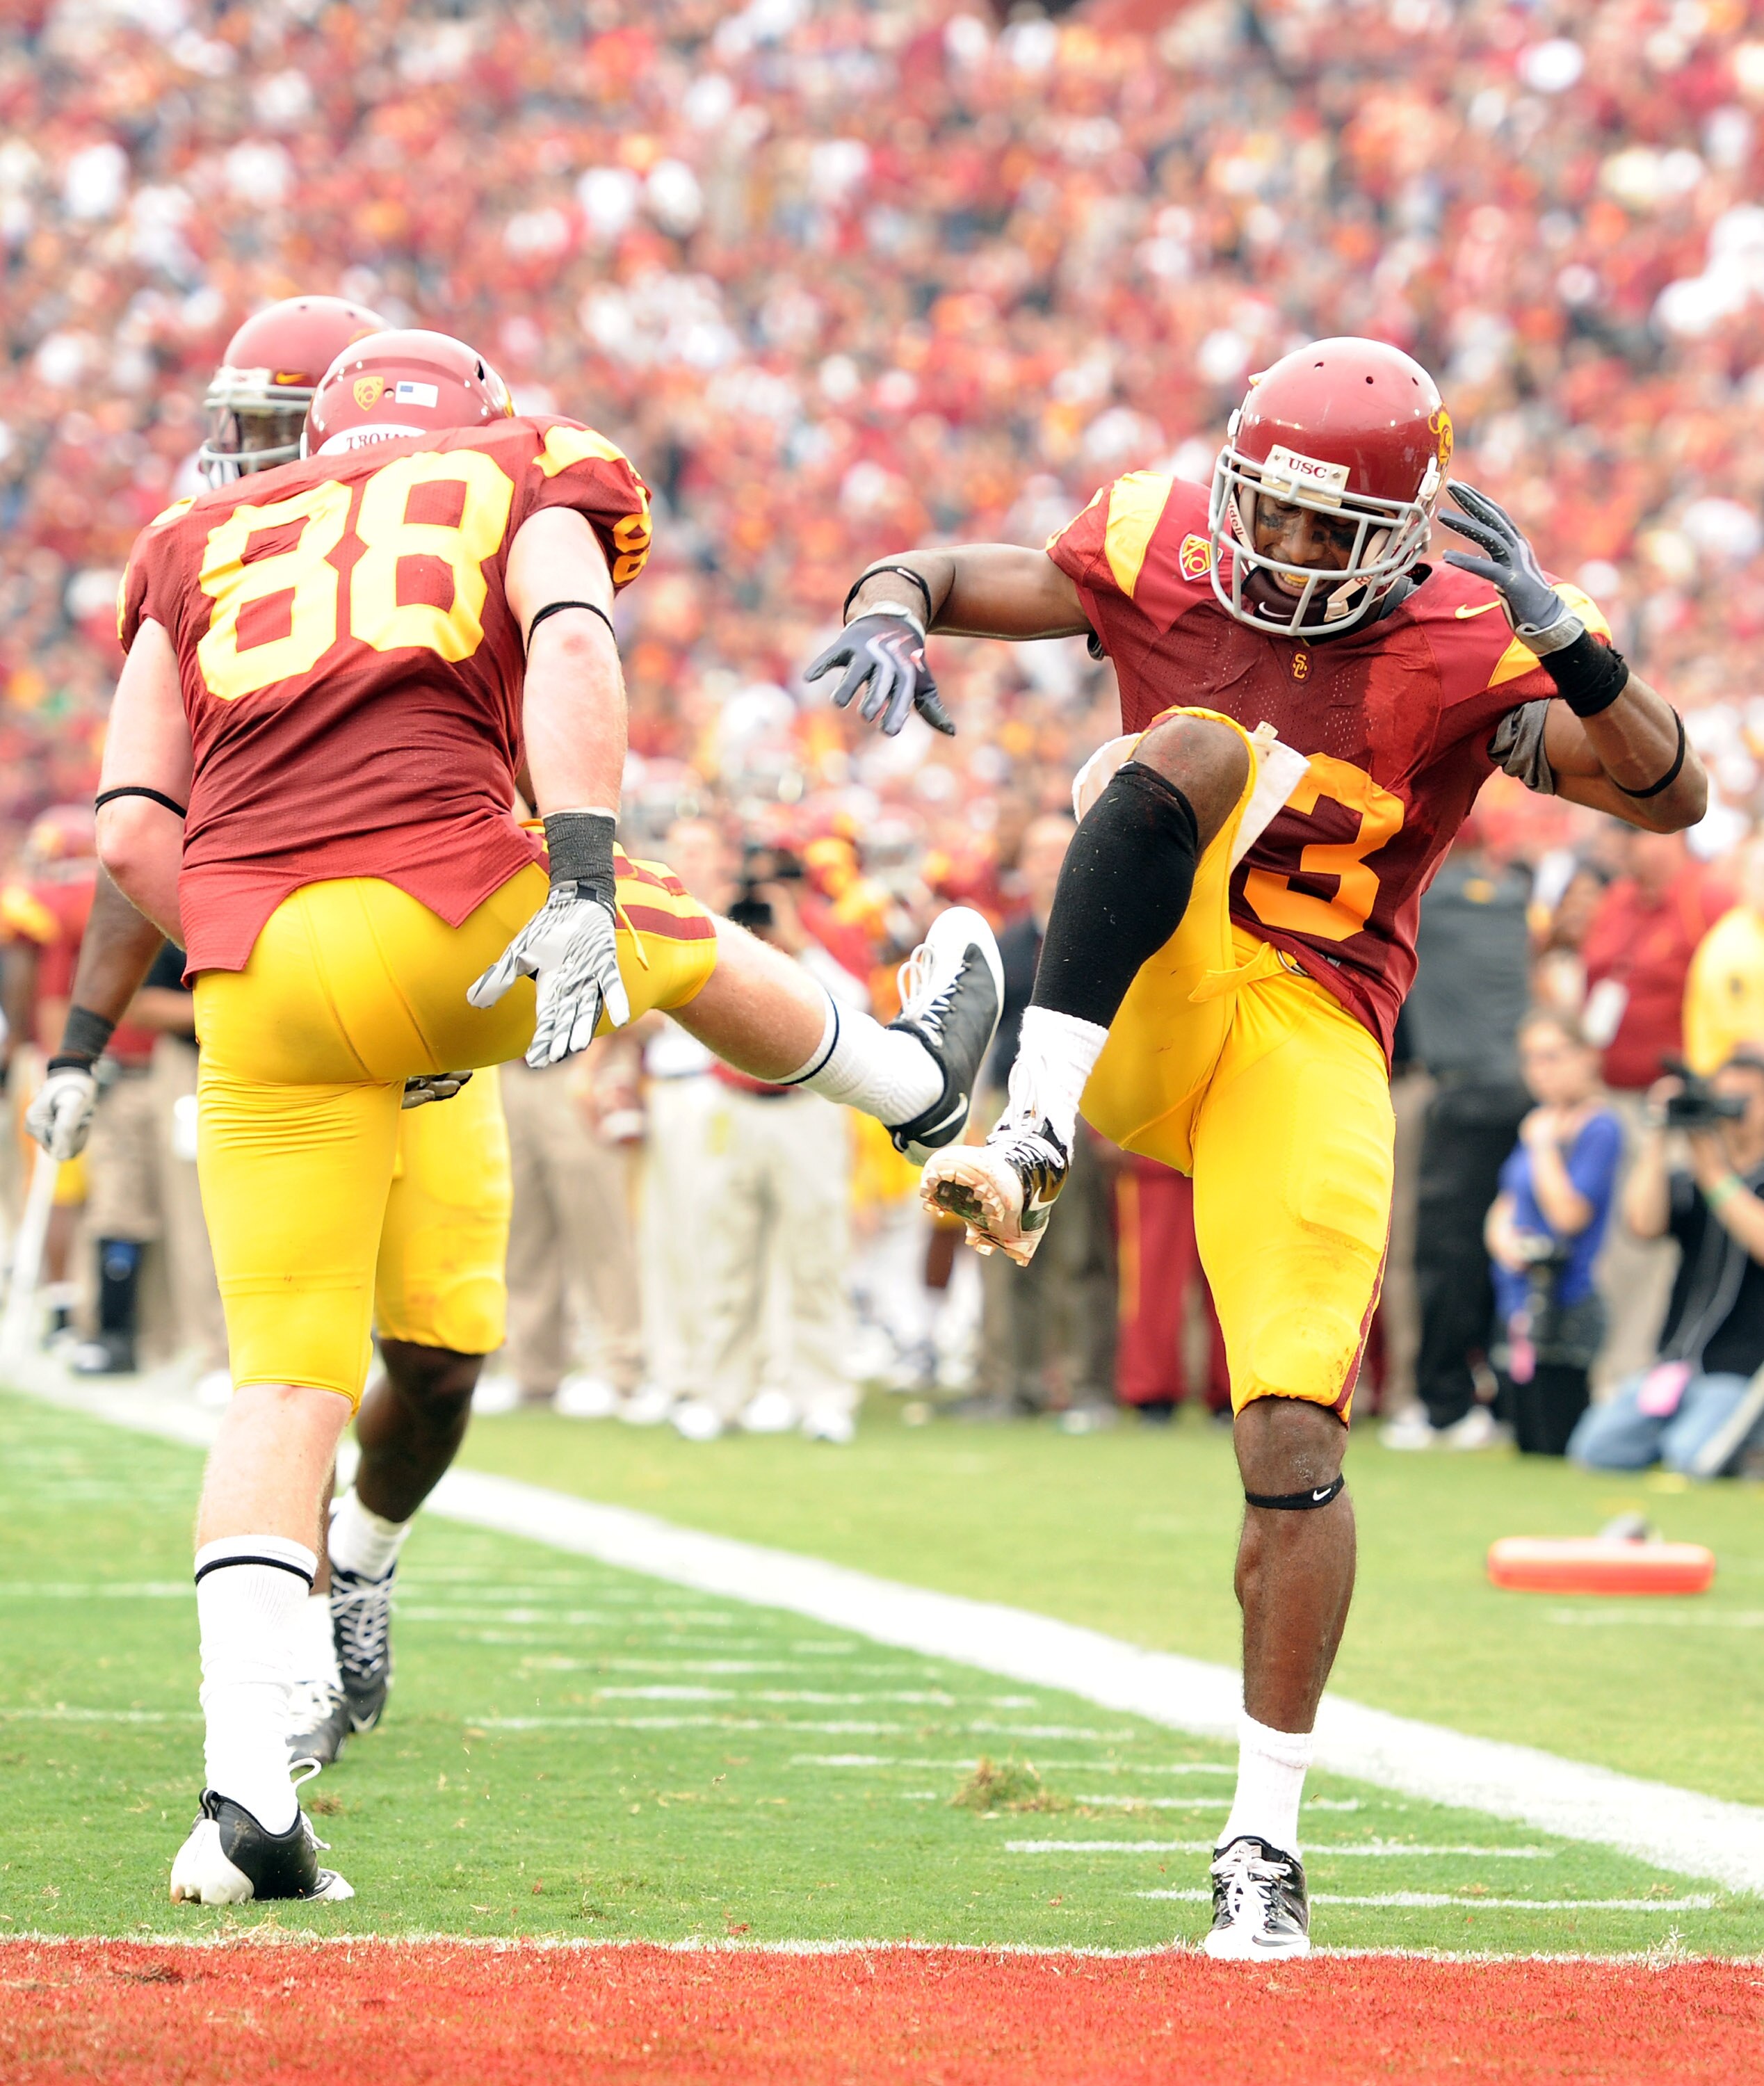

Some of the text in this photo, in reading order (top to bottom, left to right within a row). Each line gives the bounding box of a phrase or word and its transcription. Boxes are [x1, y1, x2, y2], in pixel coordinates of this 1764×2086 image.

[1288, 457, 1327, 478] USC
[197, 448, 515, 700] 88
[1243, 752, 1405, 941] 3
